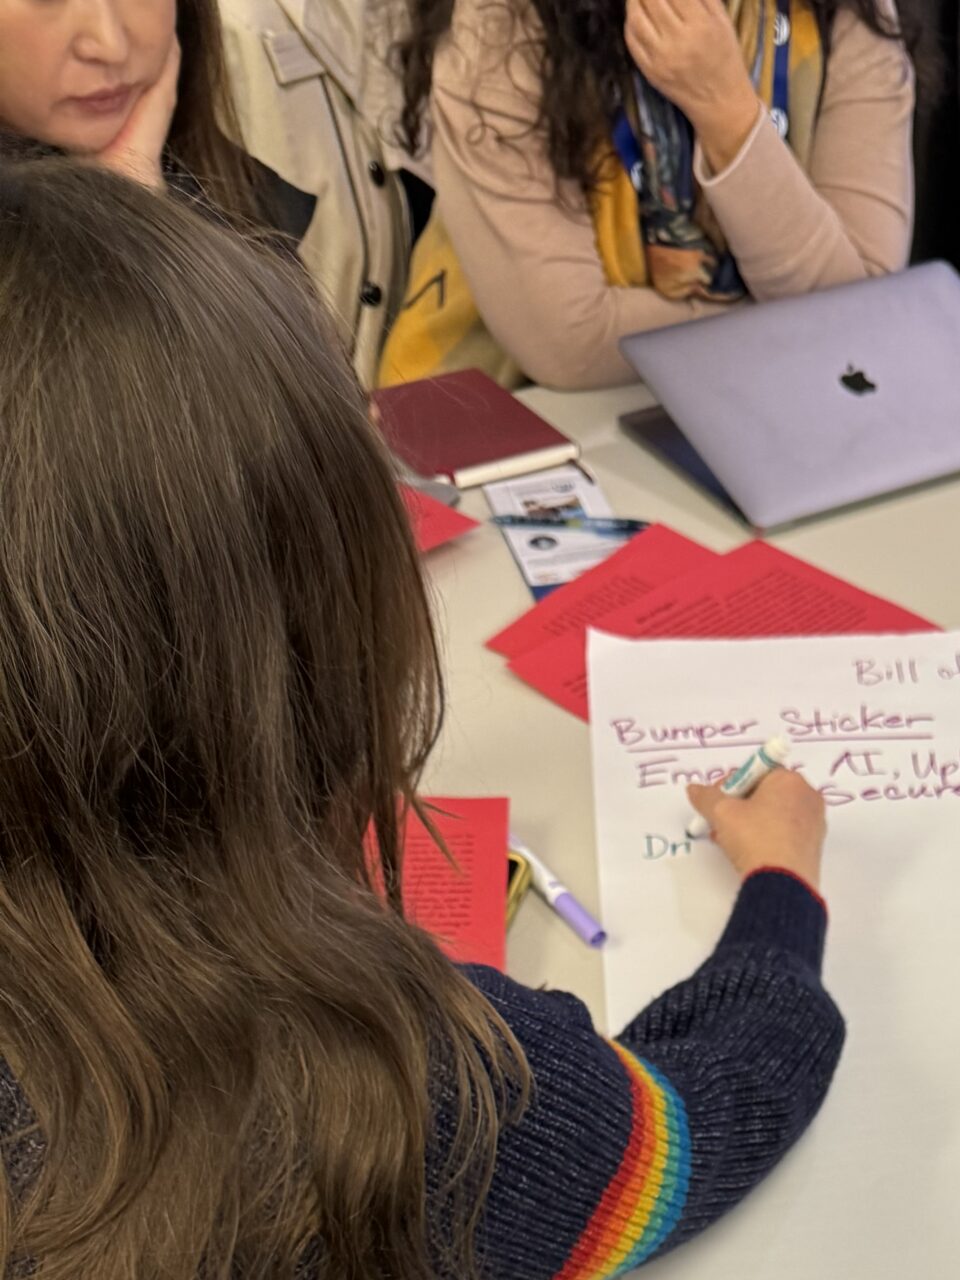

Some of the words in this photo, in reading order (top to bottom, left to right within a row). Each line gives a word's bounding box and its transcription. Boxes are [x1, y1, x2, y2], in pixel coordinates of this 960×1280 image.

[853, 658, 919, 686] Bill
[610, 717, 758, 747] Bumper
[780, 703, 935, 737] Sticker
